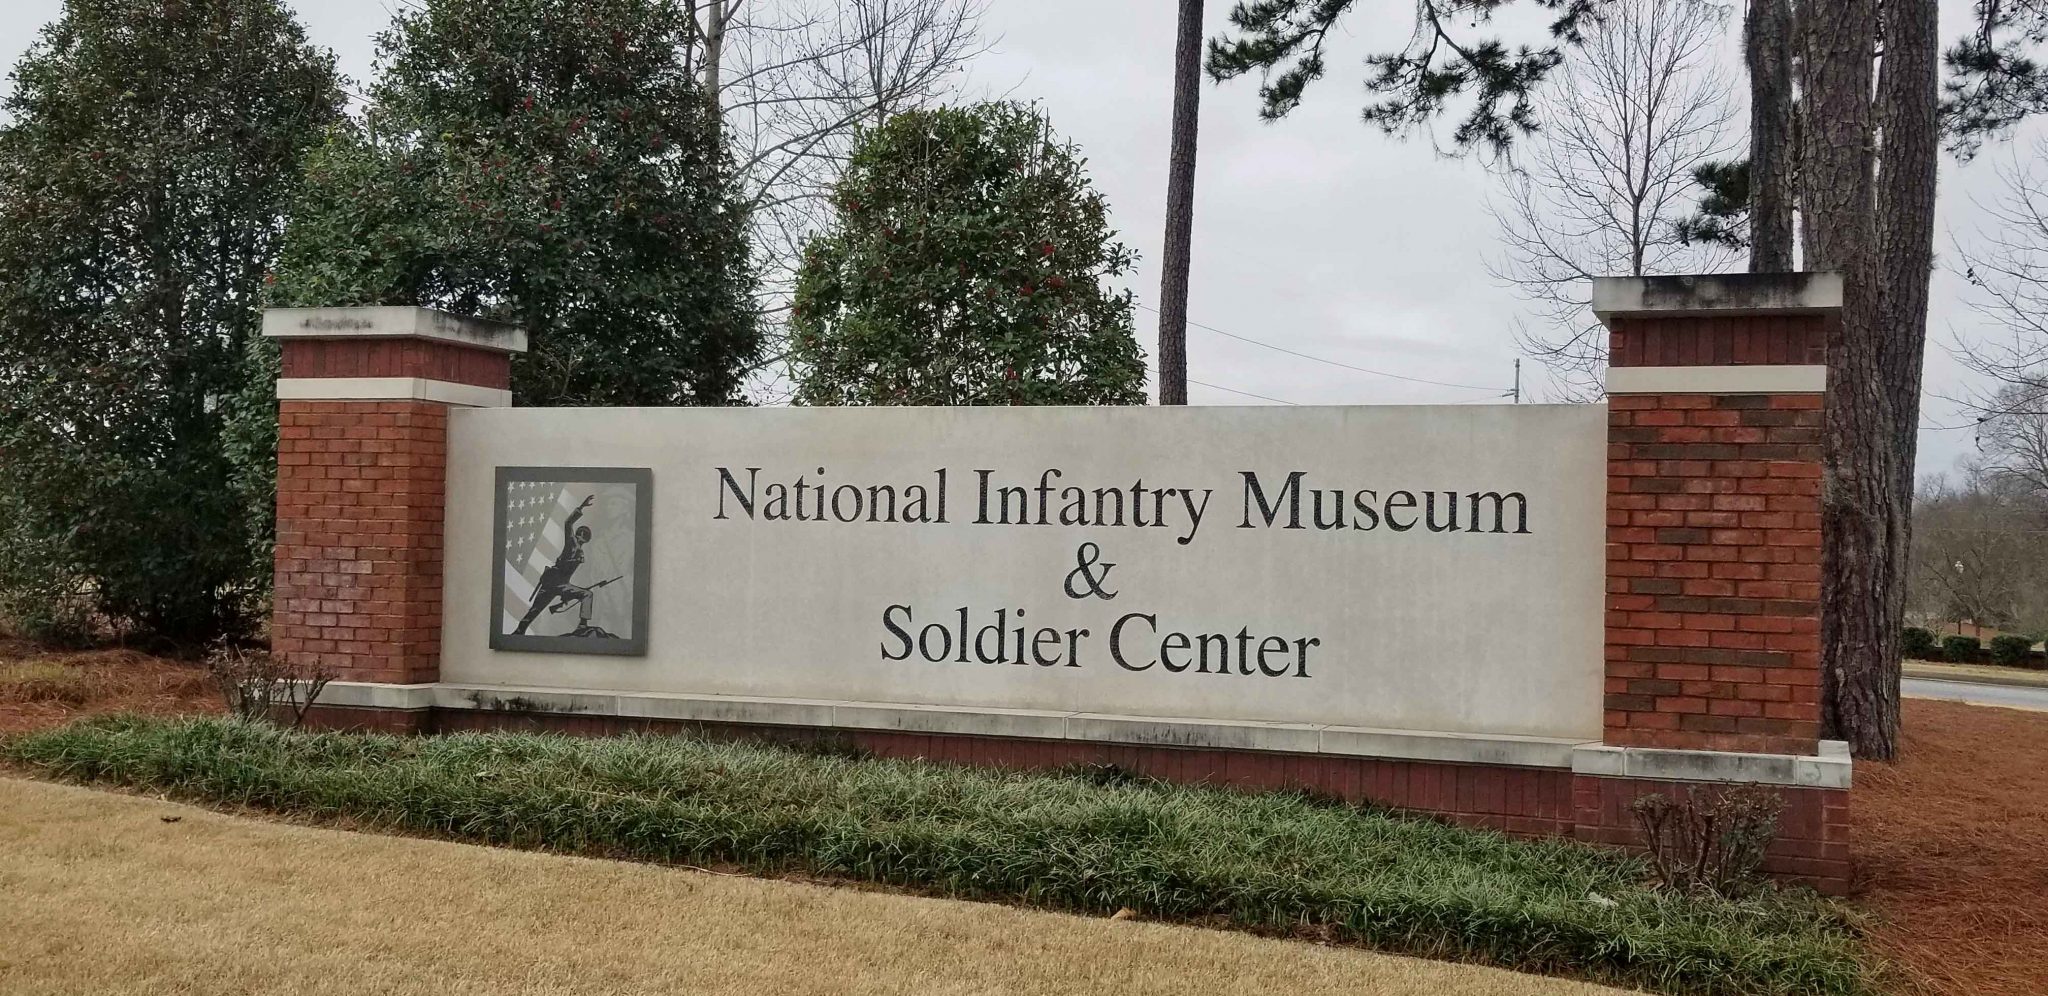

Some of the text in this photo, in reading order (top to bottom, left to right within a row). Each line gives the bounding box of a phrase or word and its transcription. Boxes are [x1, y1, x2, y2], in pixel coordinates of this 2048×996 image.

[713, 467, 1533, 546] National Infantry Museum
[1063, 541, 1119, 601] &
[880, 604, 1321, 678] Soldier Center
